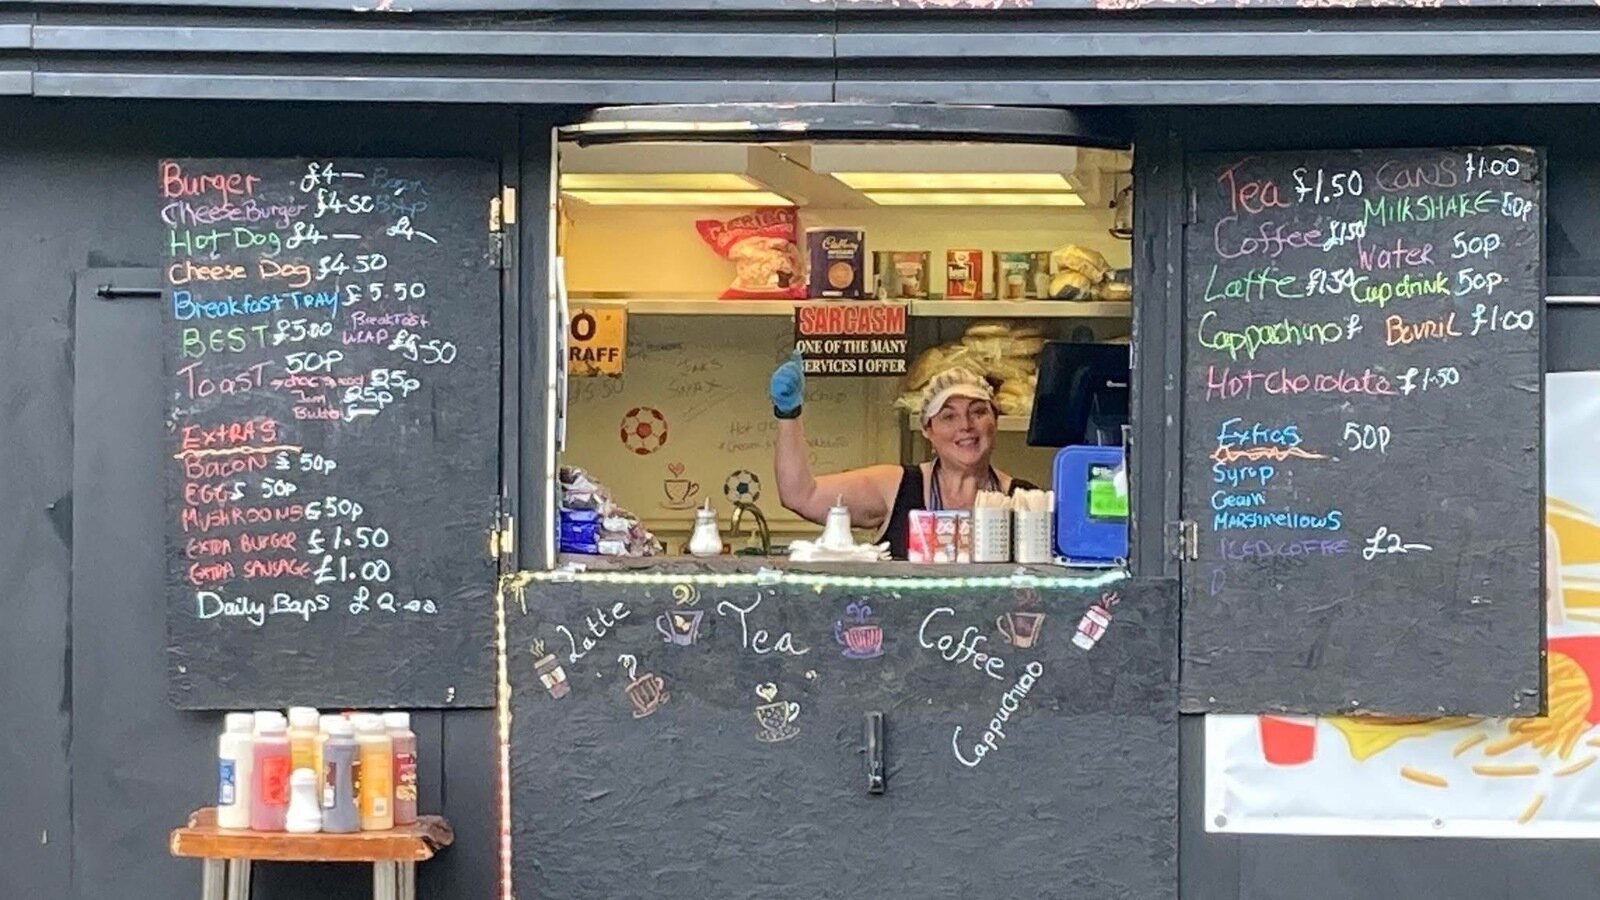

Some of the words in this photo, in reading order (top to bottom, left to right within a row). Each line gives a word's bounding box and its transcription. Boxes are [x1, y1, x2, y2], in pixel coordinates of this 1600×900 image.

[161, 161, 261, 203] Burger
[1217, 158, 1290, 213] Tea
[171, 229, 231, 256] Hot
[233, 227, 283, 256] Dog
[1213, 216, 1325, 259] Coffee
[1451, 231, 1501, 259] 50p
[259, 260, 313, 288] Dog
[1204, 264, 1304, 302] Latte
[1454, 268, 1502, 295] 50p
[173, 290, 284, 321] Breakfast
[800, 304, 905, 335] SARCASM
[180, 327, 269, 358] BEST
[569, 347, 619, 362] RAFF
[797, 340, 823, 353] ONE
[824, 340, 841, 353] OF
[842, 340, 869, 353] THE
[870, 340, 908, 353] MANY
[285, 350, 343, 374] 50p
[801, 359, 856, 373] ERVICES
[858, 359, 864, 373] I
[865, 359, 907, 373] OFFER
[1206, 365, 1266, 401] Hot
[1216, 417, 1303, 448] Extras
[1342, 421, 1391, 453] 50p
[198, 591, 265, 626] Daily
[269, 593, 331, 621] Baps
[555, 601, 632, 664] Latte
[717, 591, 810, 656] Tea
[919, 607, 1006, 680] Coffee
